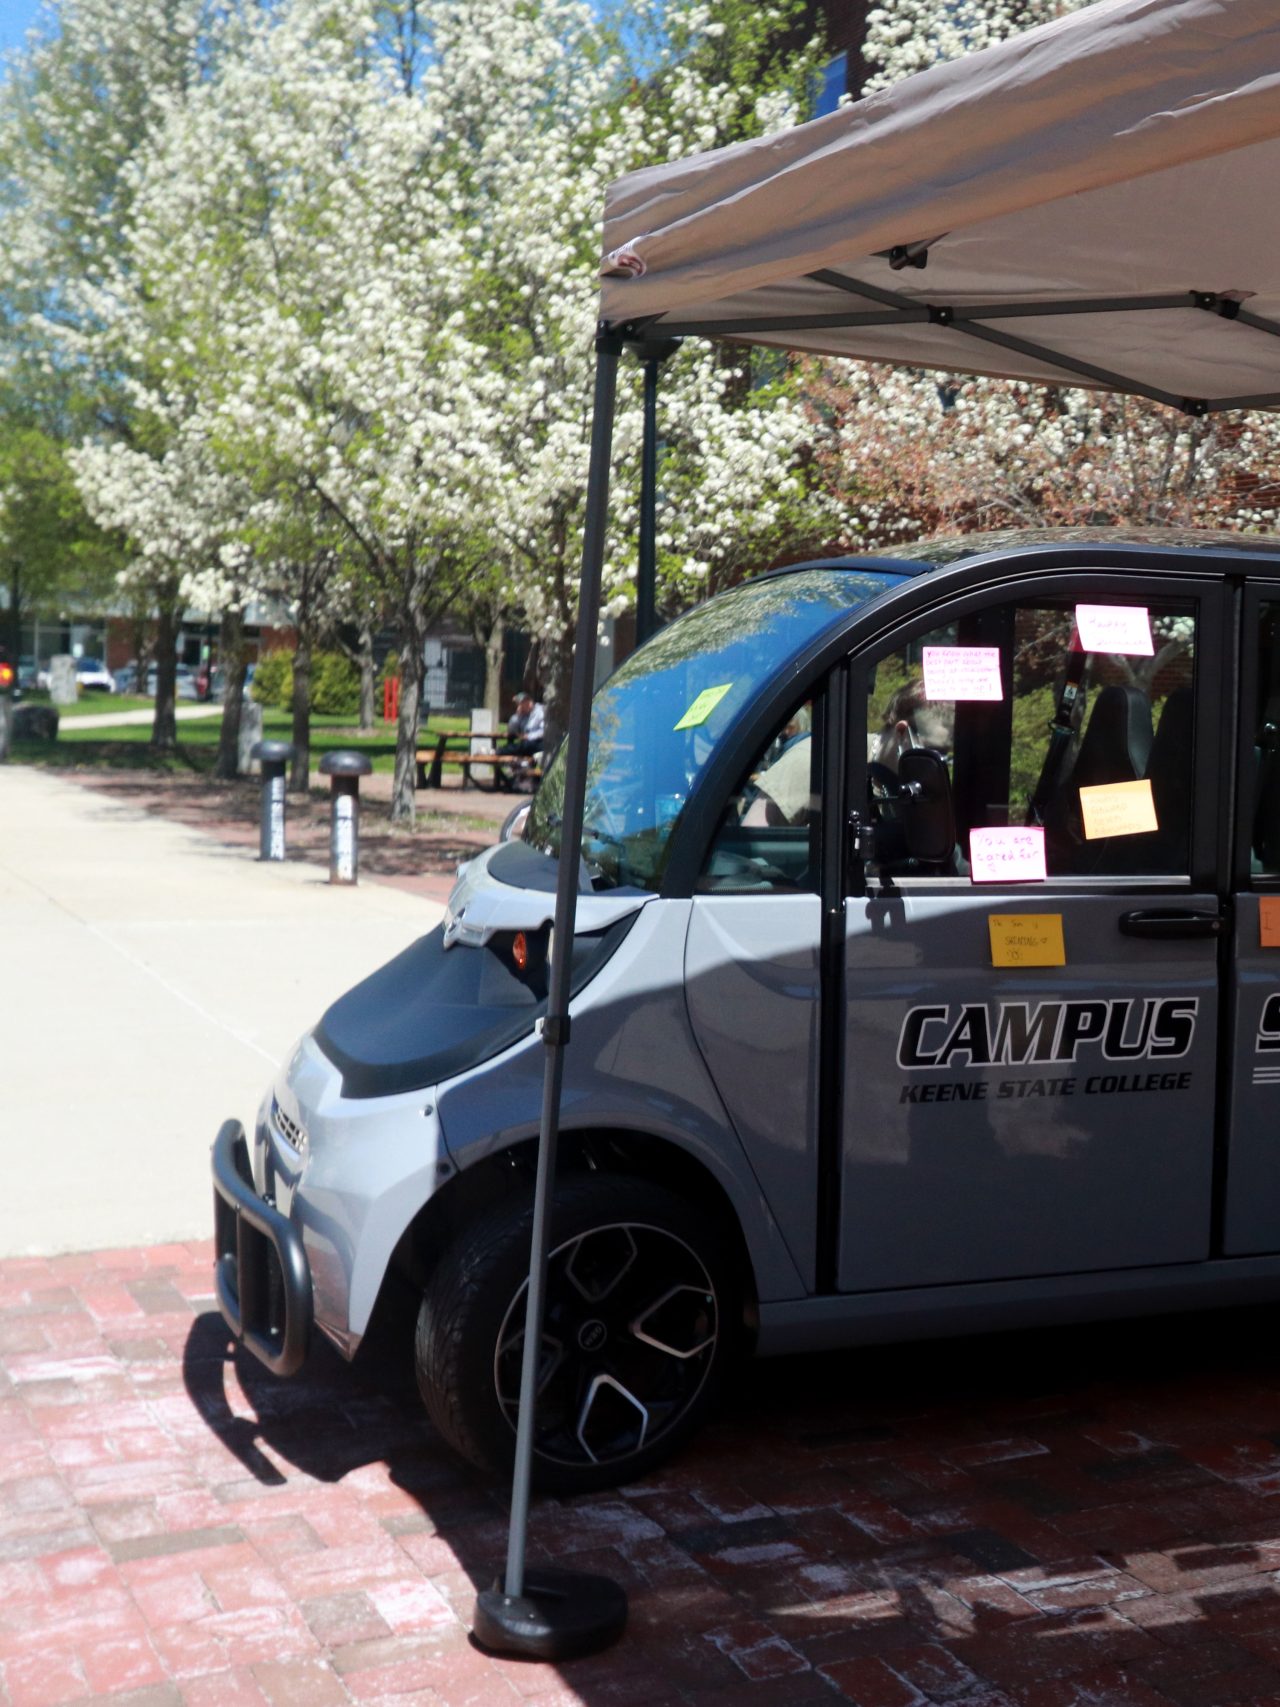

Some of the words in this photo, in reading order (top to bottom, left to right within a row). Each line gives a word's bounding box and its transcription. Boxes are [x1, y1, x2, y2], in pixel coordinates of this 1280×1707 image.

[896, 997, 1199, 1069] CAMPUS
[899, 1082, 988, 1104] KEENE
[996, 1077, 1077, 1099] STATE
[1084, 1071, 1193, 1095] COLLEGE
